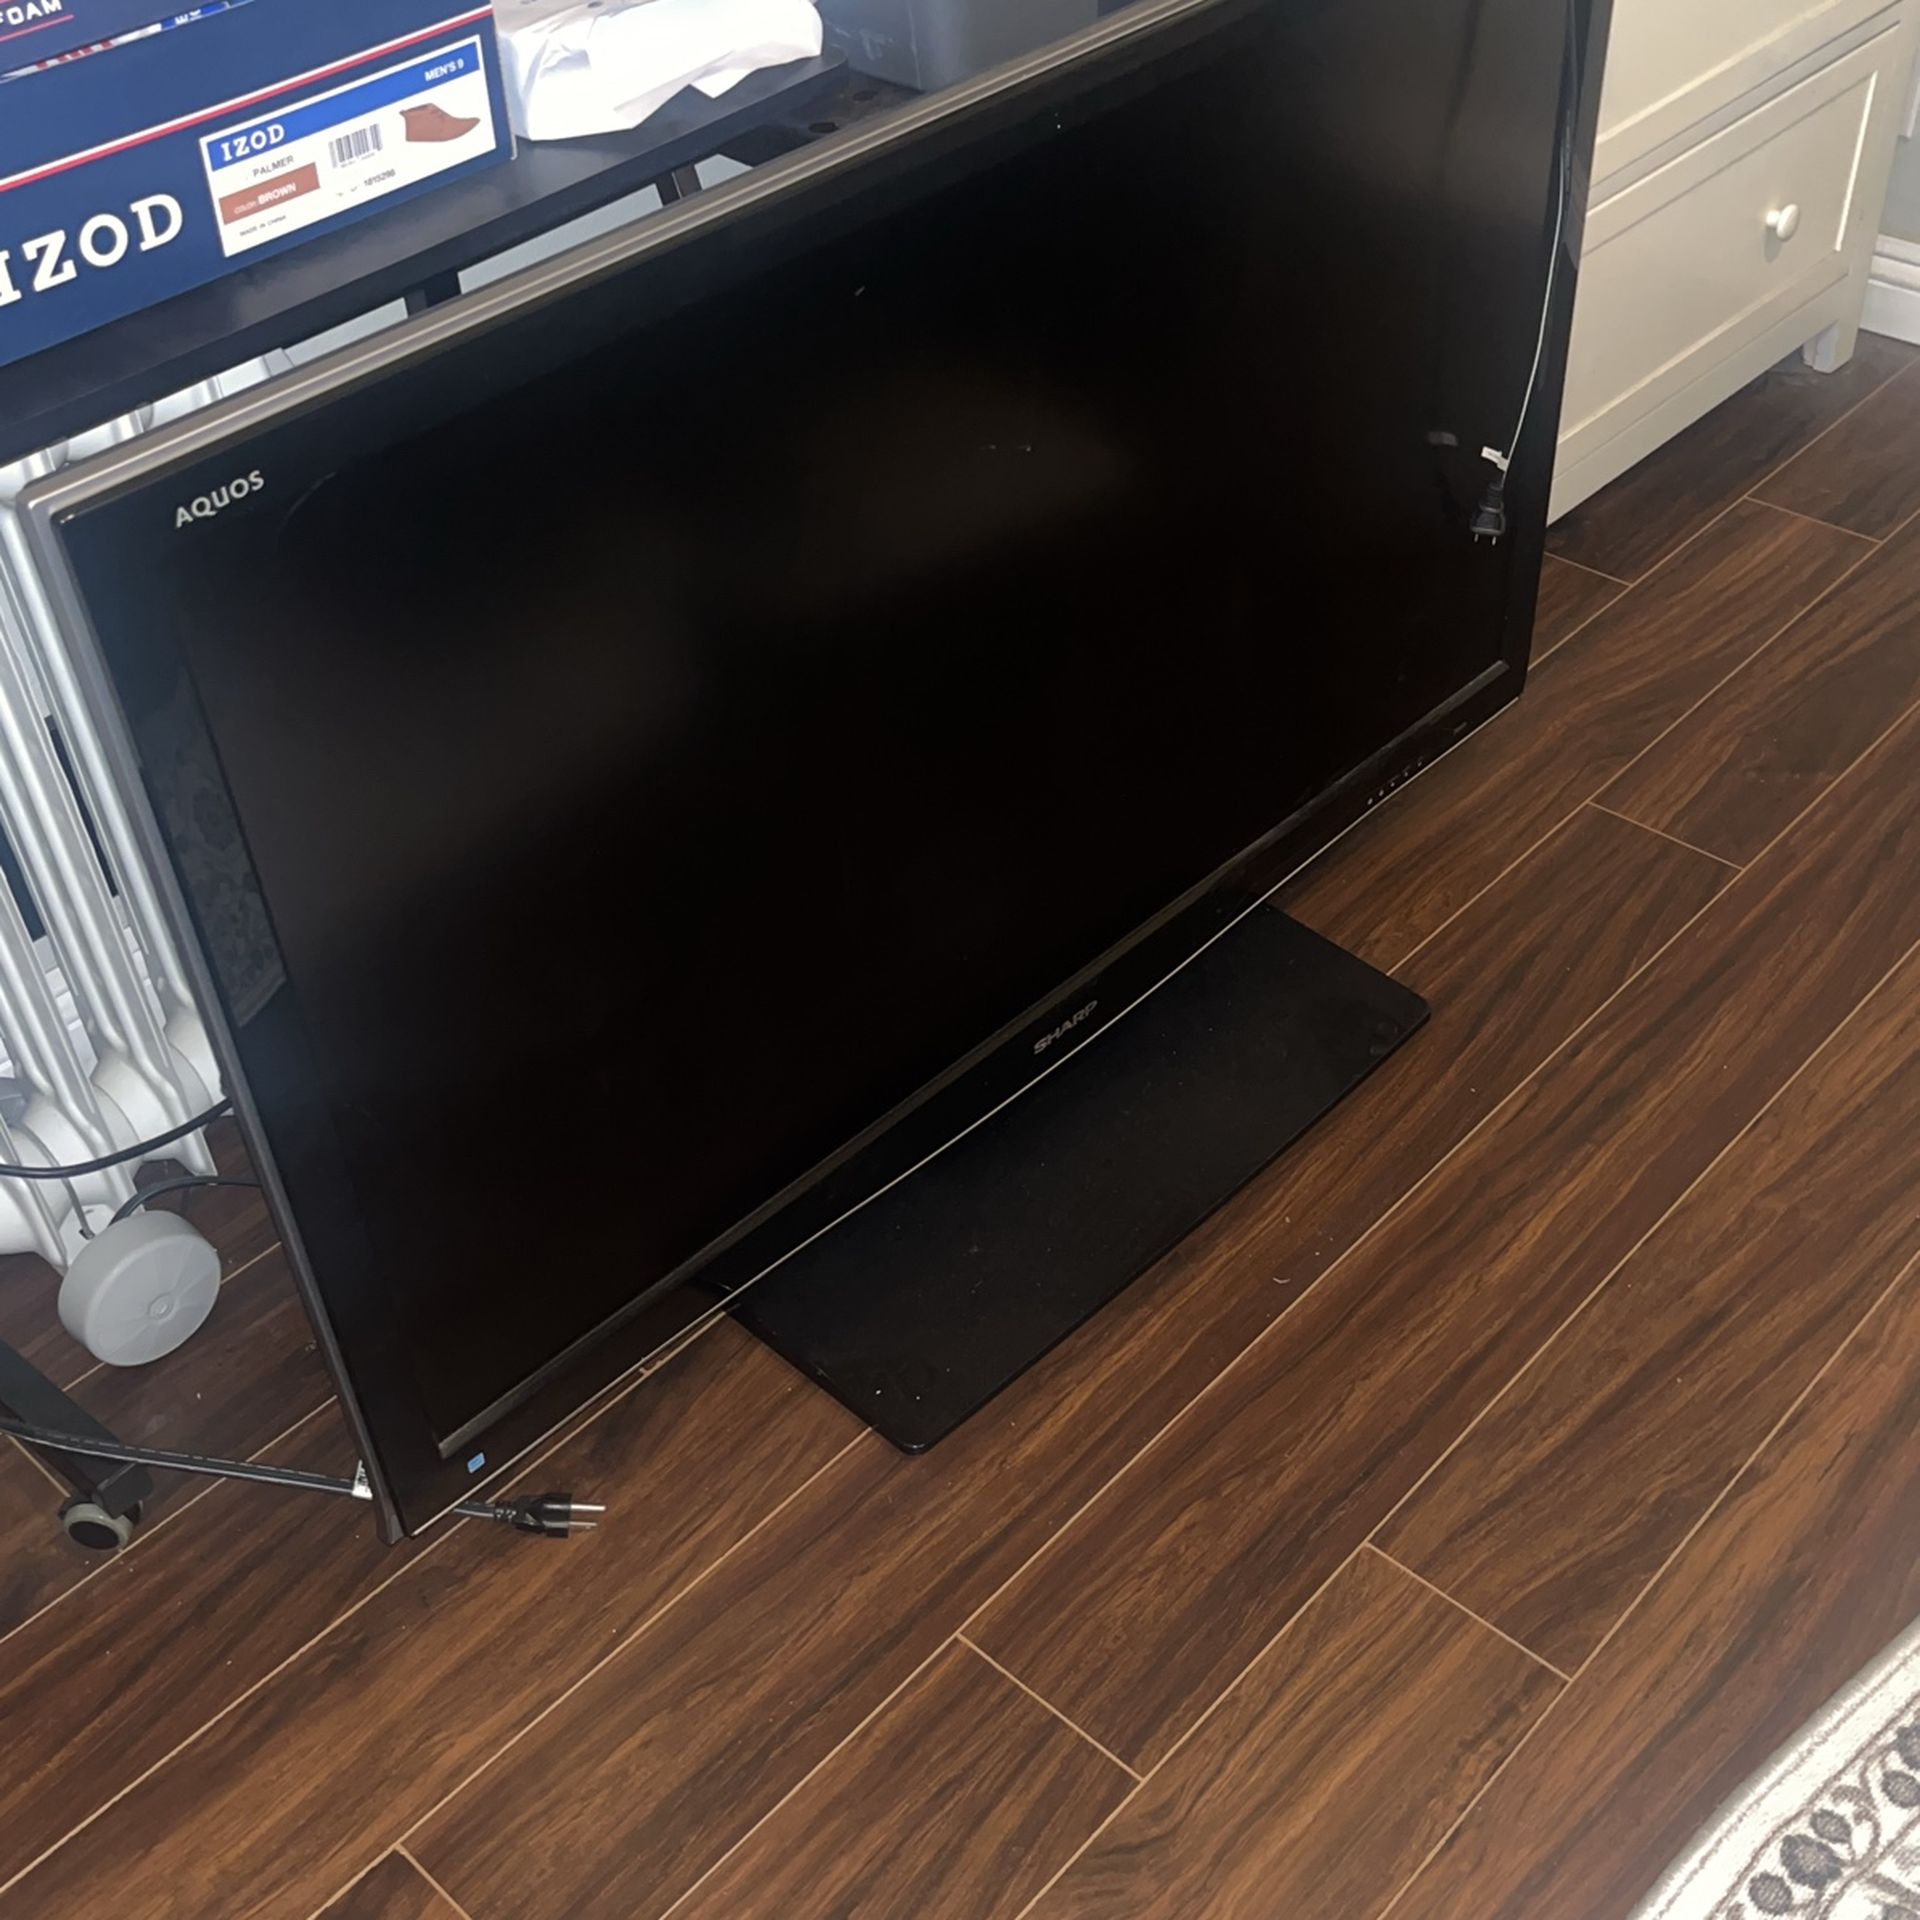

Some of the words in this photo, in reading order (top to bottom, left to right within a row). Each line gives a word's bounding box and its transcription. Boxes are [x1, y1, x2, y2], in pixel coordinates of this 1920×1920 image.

[0, 0, 62, 25] OAM
[424, 61, 457, 82] MEN'S
[220, 124, 285, 161] IZOD
[252, 155, 294, 177] PALMER
[257, 182, 297, 205] BROWN
[0, 194, 183, 306] IZOD
[176, 469, 265, 529] AQUOS
[1033, 999, 1098, 1055] SHARP
